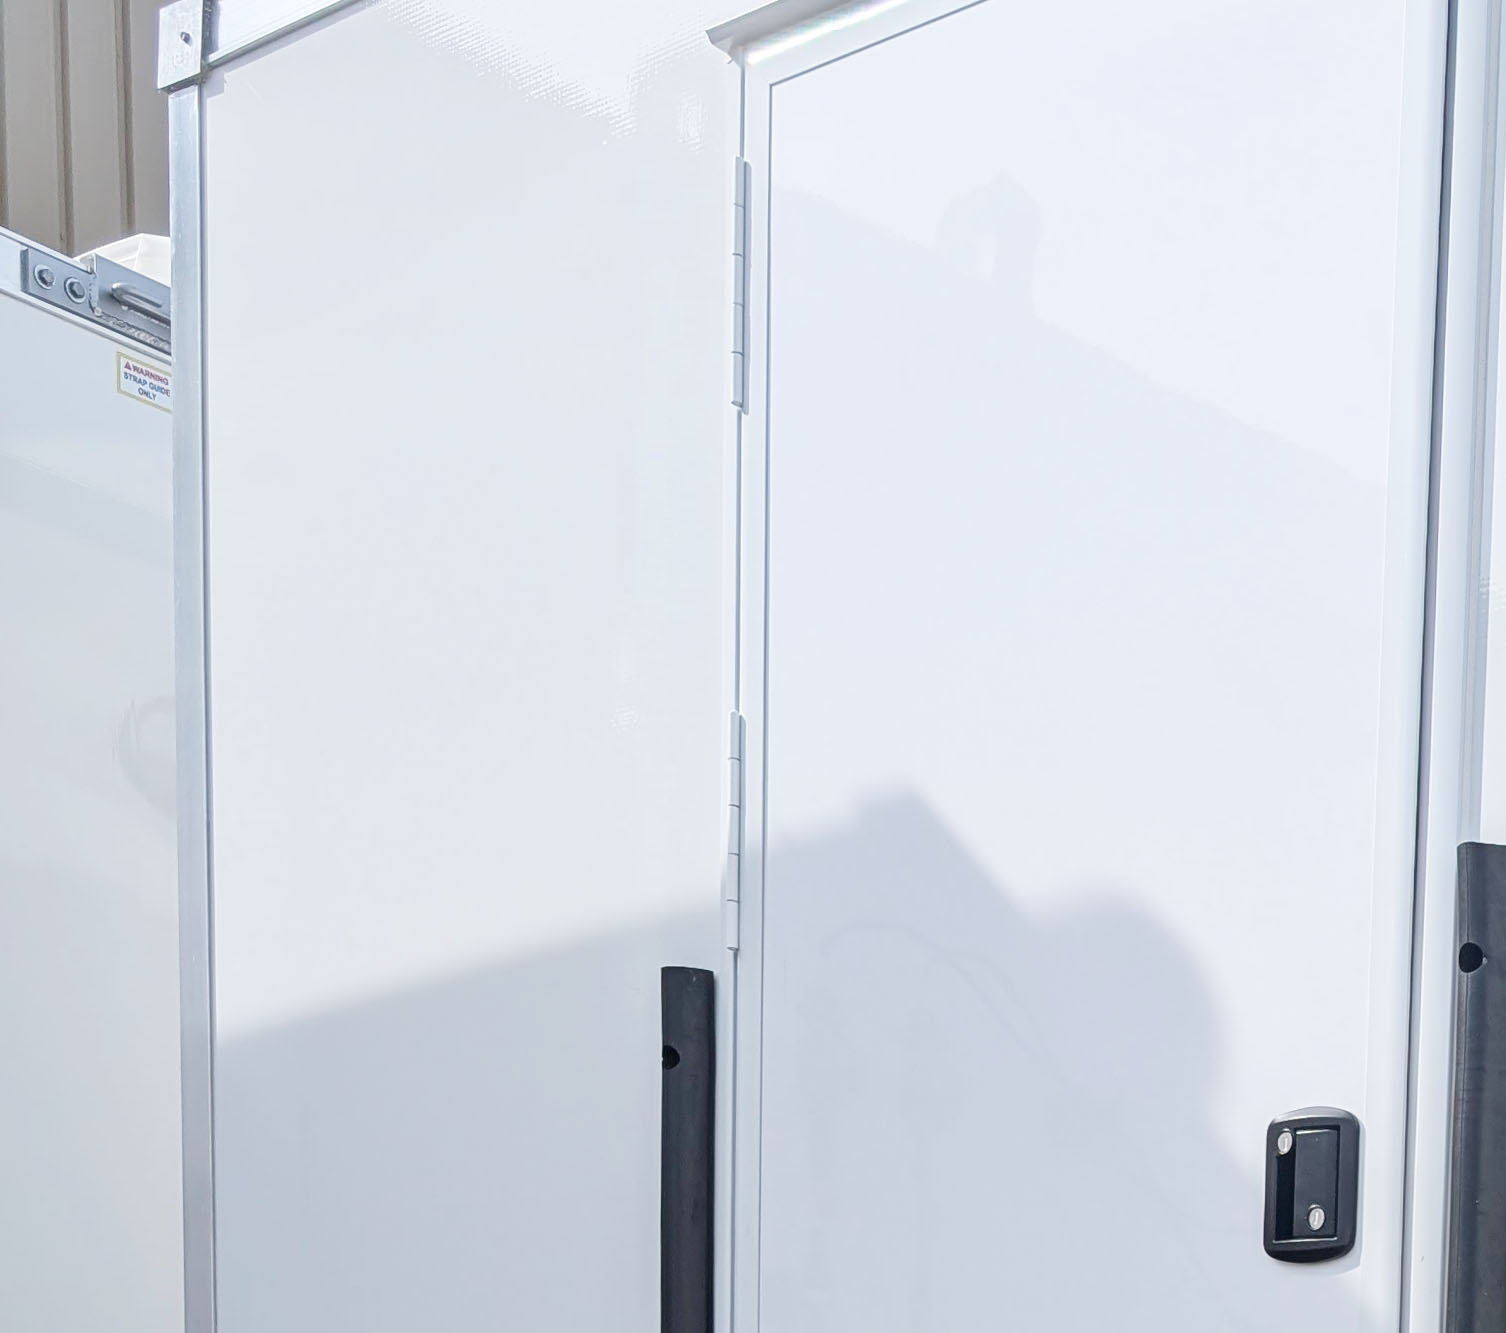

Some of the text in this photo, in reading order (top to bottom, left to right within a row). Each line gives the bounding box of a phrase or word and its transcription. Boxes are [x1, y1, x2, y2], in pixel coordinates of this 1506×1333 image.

[124, 371, 171, 398] STRAP GUIDE
[132, 363, 169, 386] WARNING
[138, 387, 156, 401] ONLY
